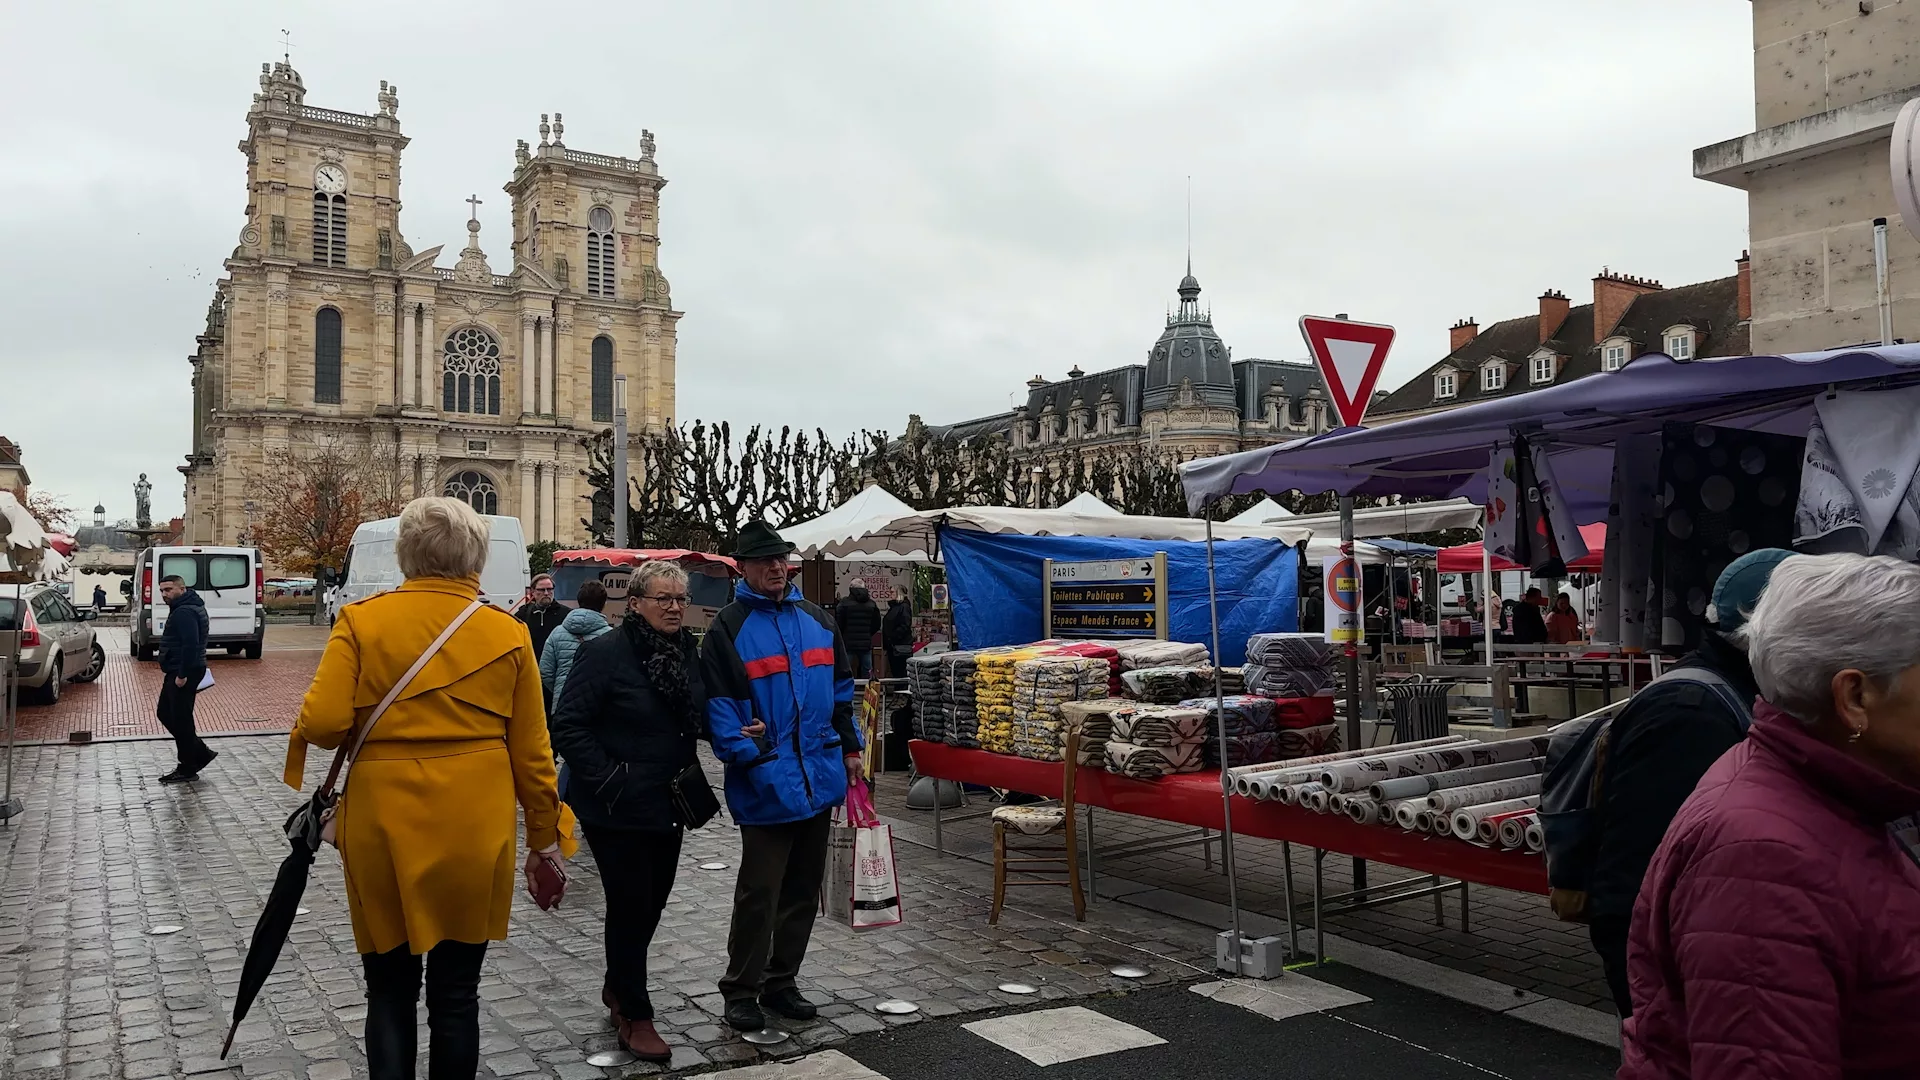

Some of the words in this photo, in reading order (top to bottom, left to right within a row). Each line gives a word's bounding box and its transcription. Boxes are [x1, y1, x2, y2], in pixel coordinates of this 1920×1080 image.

[1052, 567, 1076, 577] PARIS
[604, 578, 614, 589] LA
[1052, 591, 1083, 601] Toilettes
[1086, 590, 1125, 602] Publiques
[1052, 615, 1077, 627] Espace
[1113, 615, 1140, 626] France
